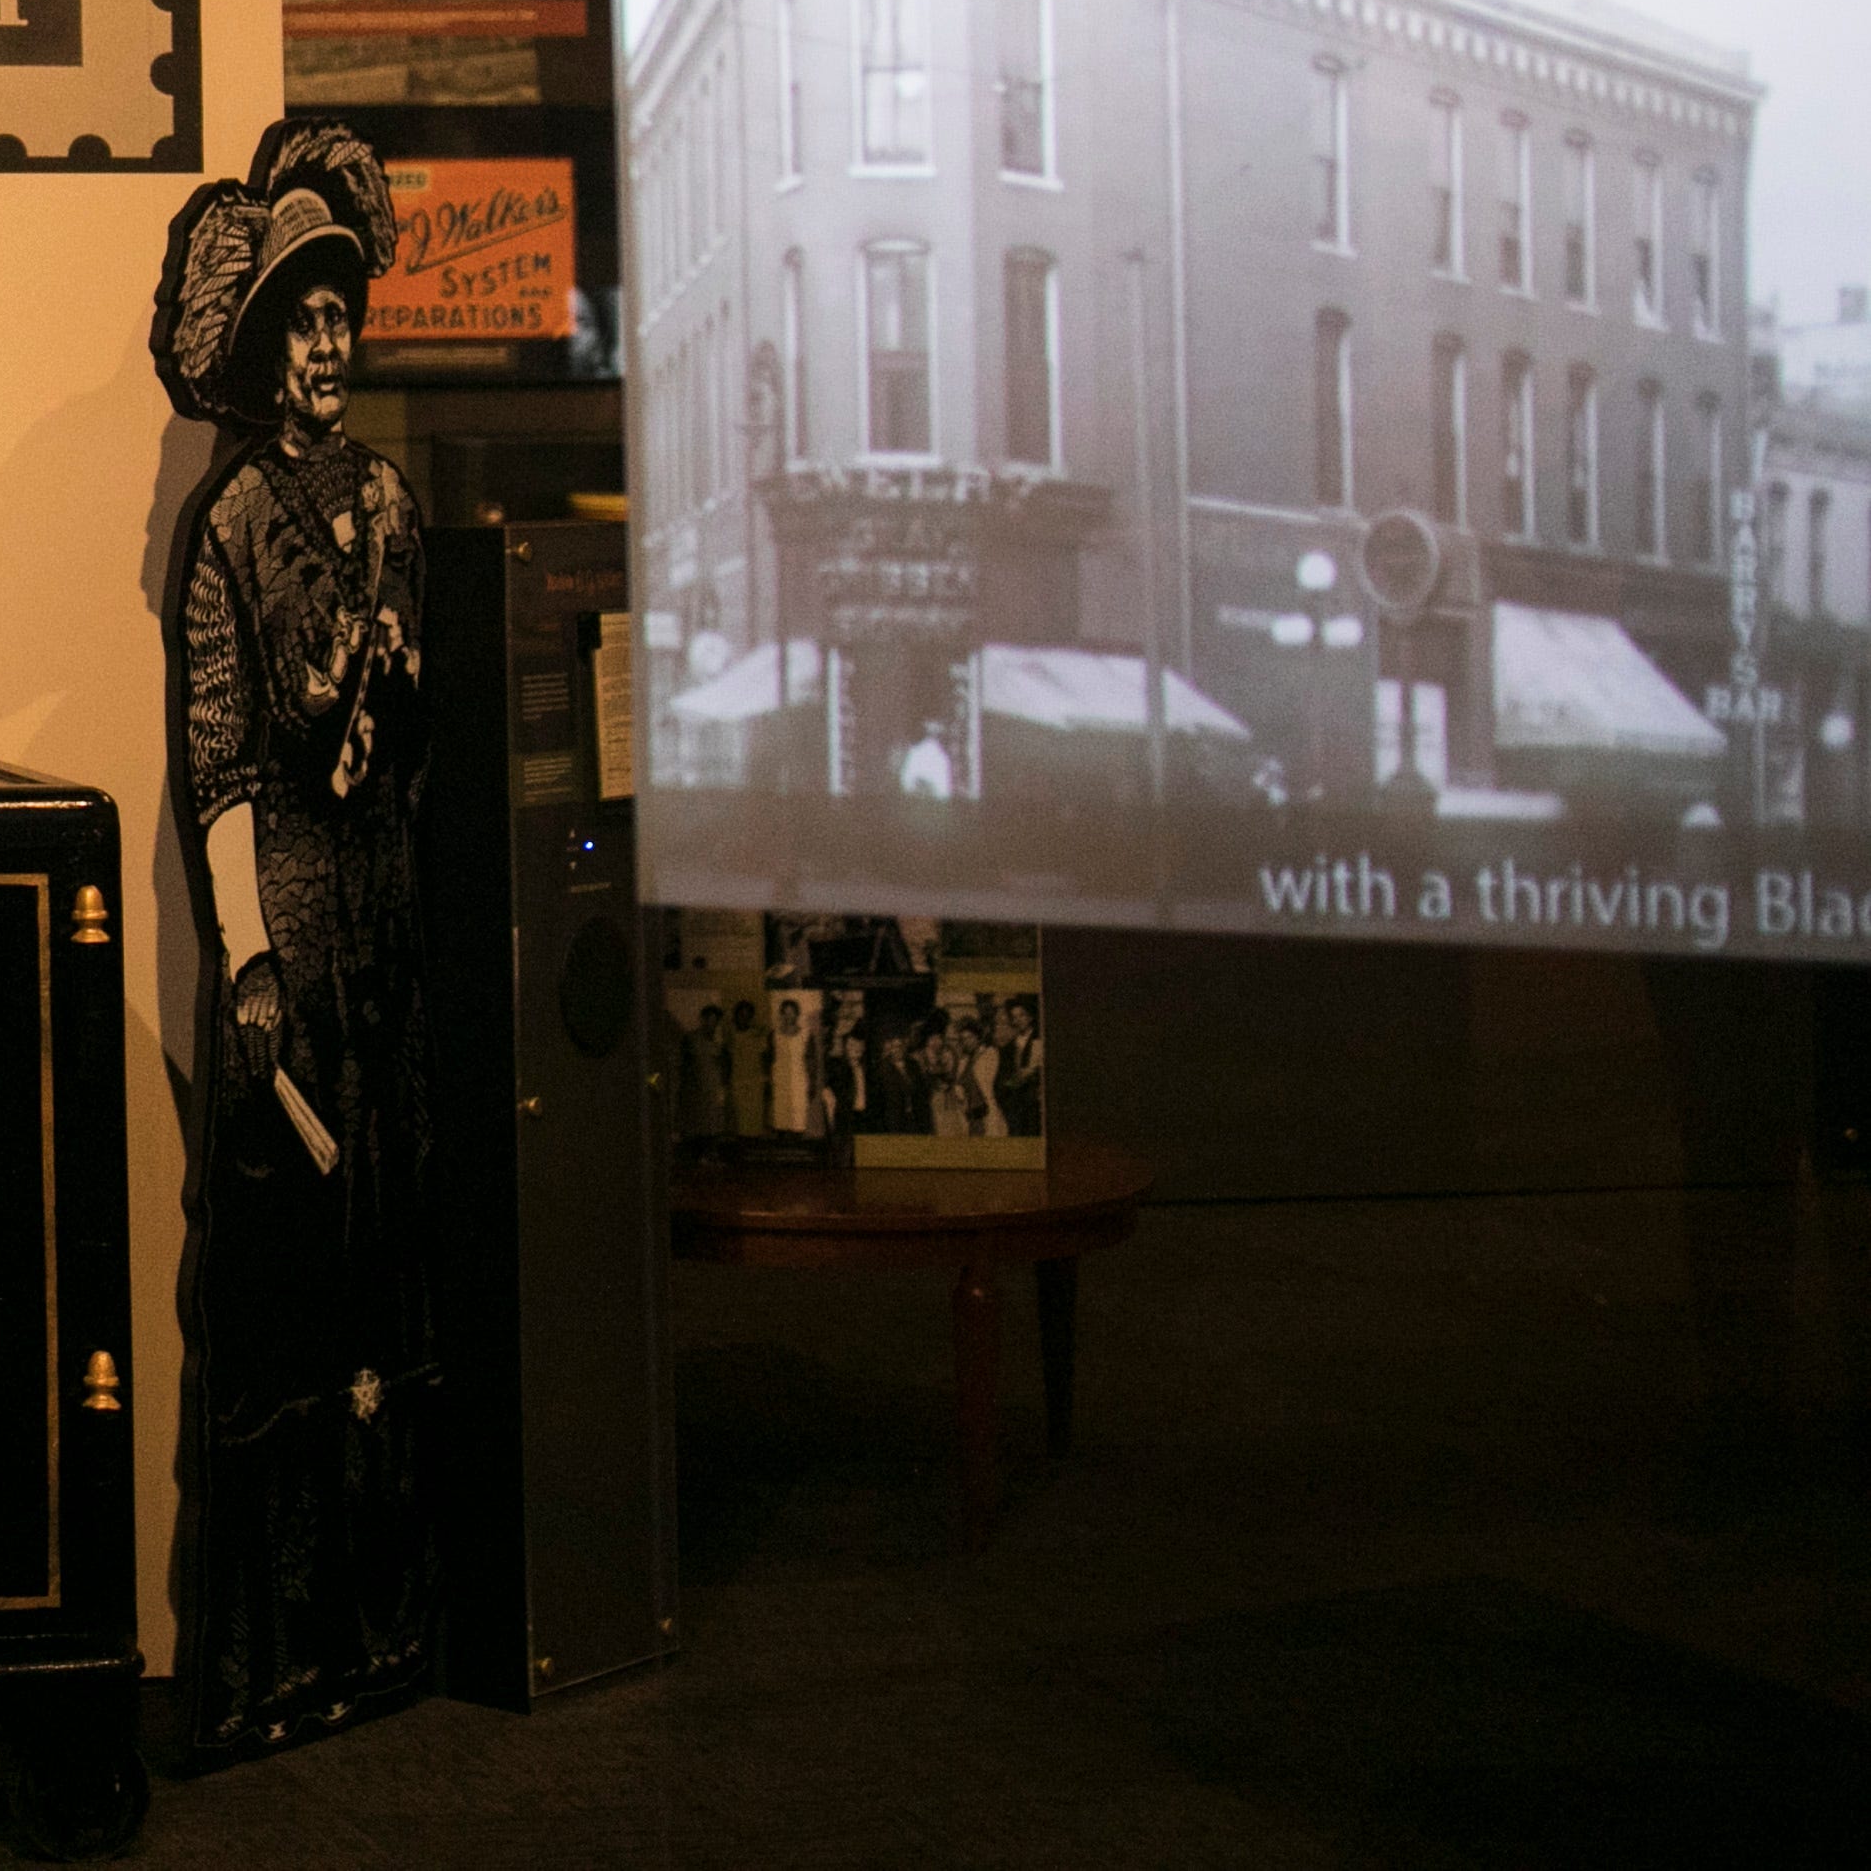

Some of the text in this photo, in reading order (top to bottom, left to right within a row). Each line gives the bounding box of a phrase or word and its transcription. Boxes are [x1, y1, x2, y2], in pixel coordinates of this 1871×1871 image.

[1260, 853, 1396, 917] with
[1417, 871, 1452, 919] a
[1475, 857, 1731, 950] thriving
